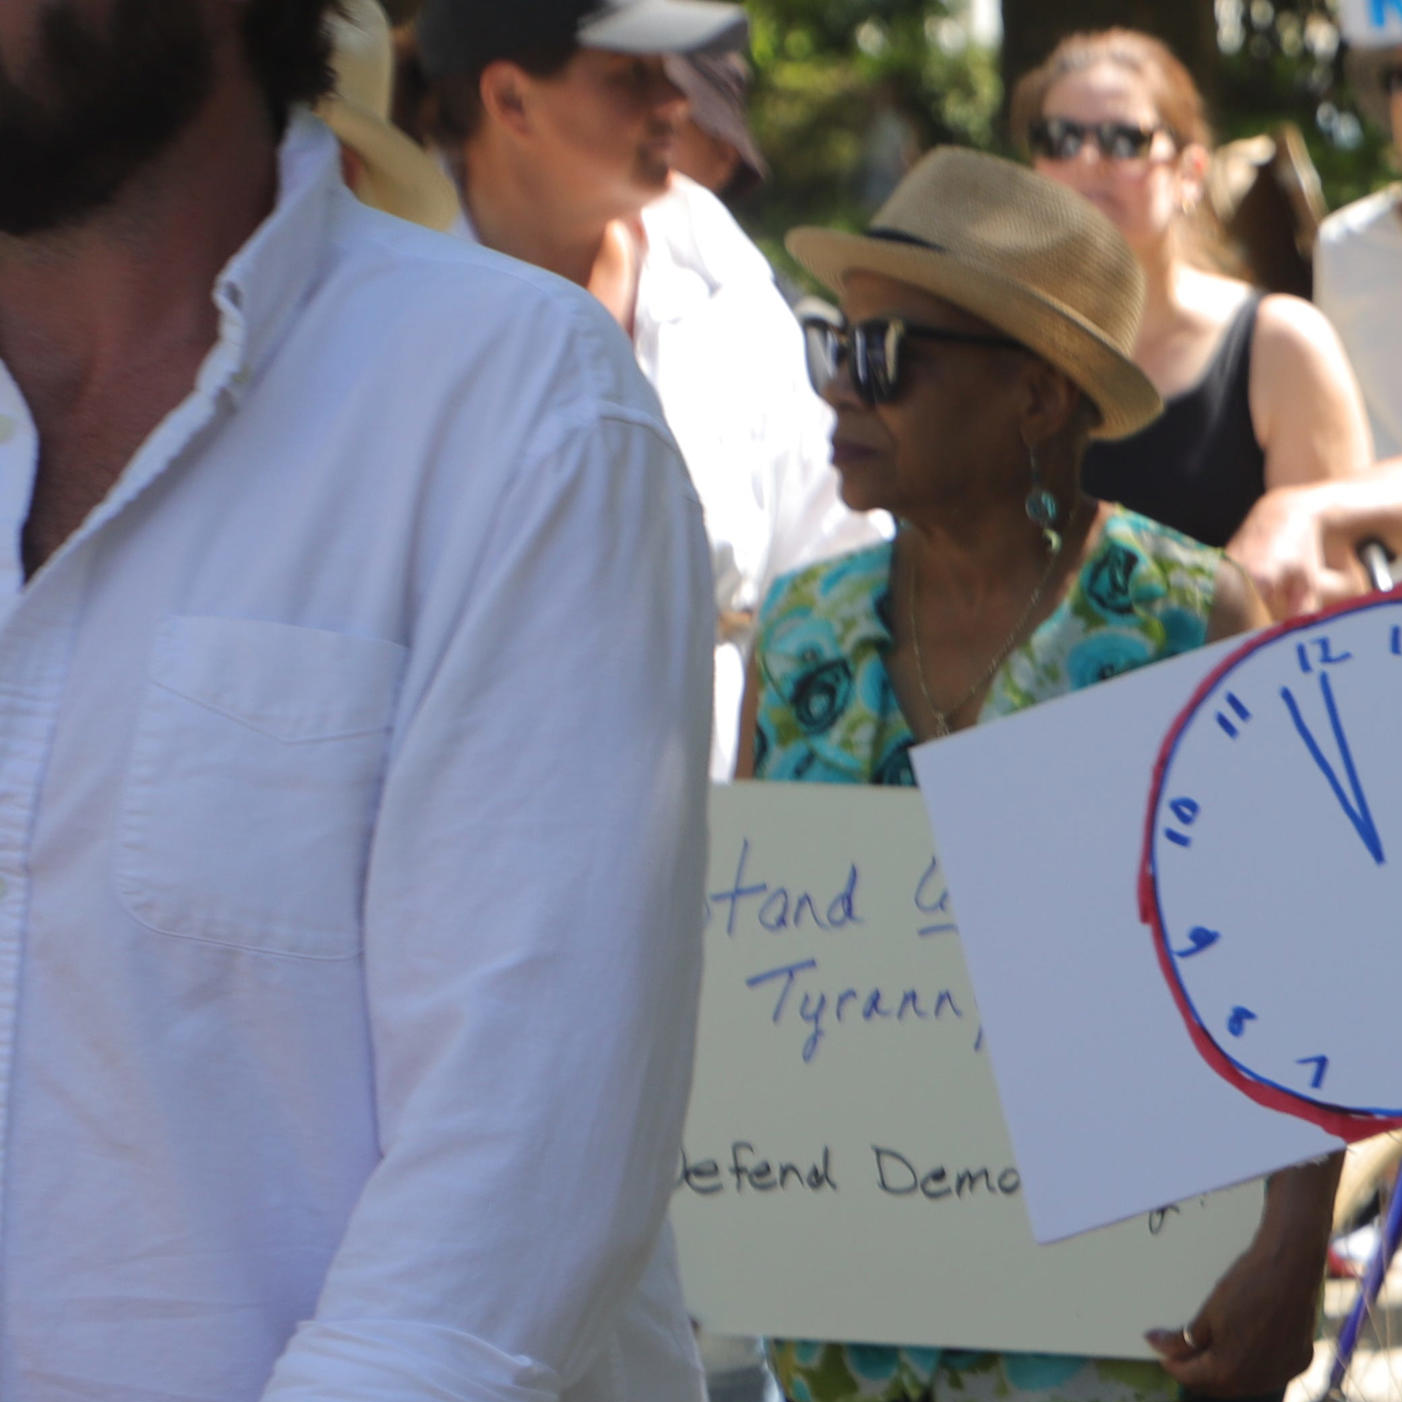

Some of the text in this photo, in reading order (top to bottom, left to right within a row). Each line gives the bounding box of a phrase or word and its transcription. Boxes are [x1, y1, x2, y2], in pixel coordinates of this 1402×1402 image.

[1296, 637, 1353, 674] 12
[1388, 624, 1402, 657] 1
[1215, 690, 1252, 740] 11
[1163, 795, 1200, 848] 10
[704, 838, 863, 937] tand
[1172, 924, 1222, 959] 9
[745, 959, 983, 1063] Tyrann
[1226, 1004, 1258, 1039] 8
[1294, 1054, 1330, 1090] 7
